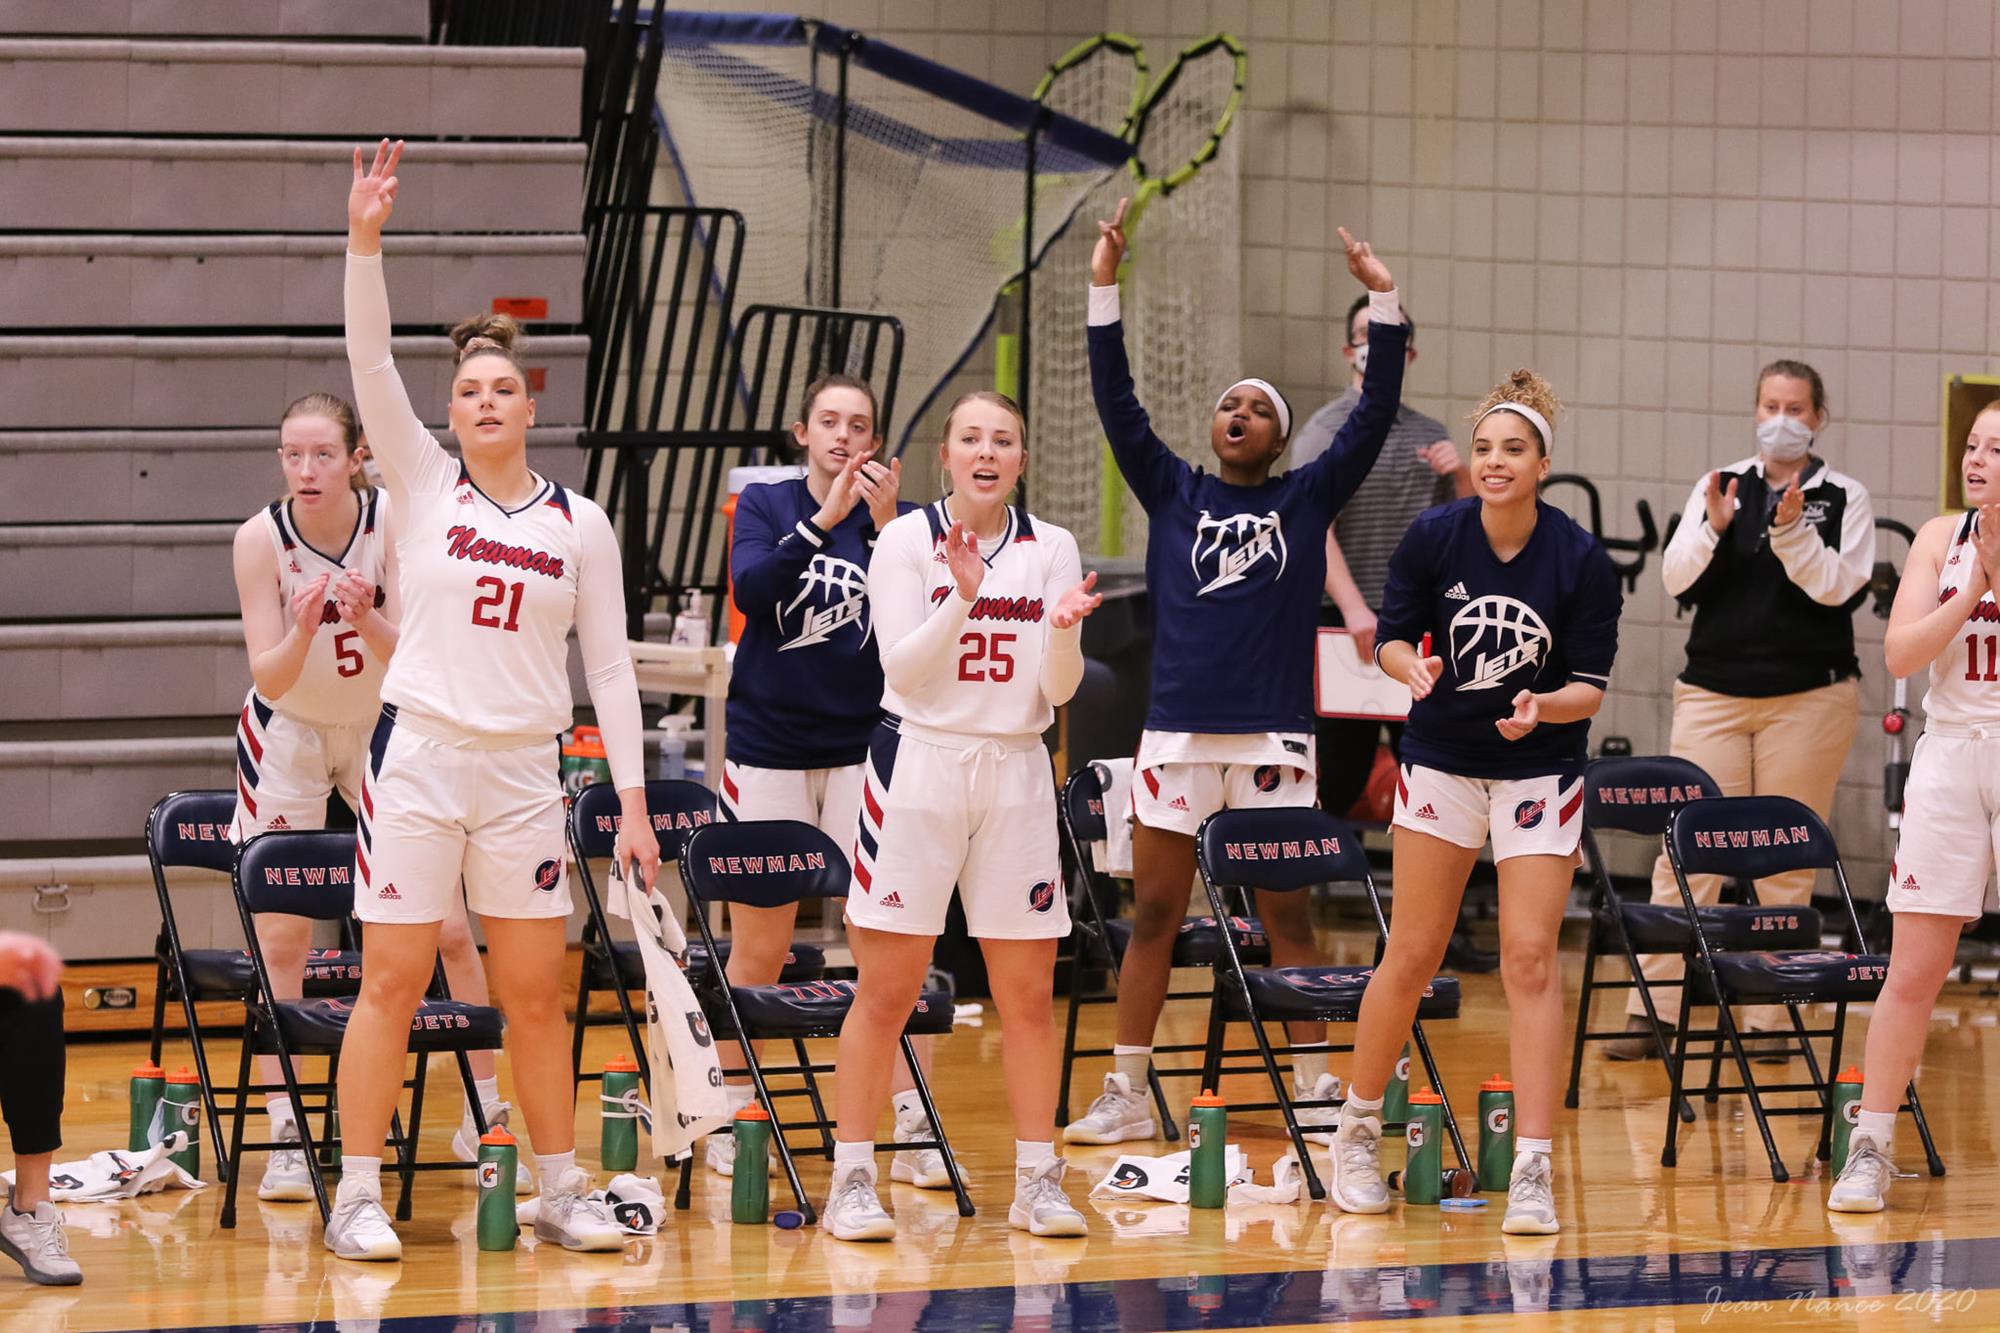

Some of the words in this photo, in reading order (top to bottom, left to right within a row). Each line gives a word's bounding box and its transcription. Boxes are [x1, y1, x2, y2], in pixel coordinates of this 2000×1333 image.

[447, 525, 564, 579] Newman
[472, 576, 525, 632] 21
[931, 586, 1044, 623] wman
[1445, 592, 1470, 601] adidas
[334, 630, 364, 678] 5
[958, 633, 1017, 682] 25
[1965, 634, 1997, 682] 11
[1598, 785, 1702, 804] NEWMAN
[595, 810, 712, 832] NMAN
[1415, 811, 1439, 821] adidas
[178, 823, 231, 841] NEW
[1695, 826, 1809, 849] NEWMAN
[1225, 838, 1341, 860] NEWMAN
[708, 852, 826, 874] NEWMAN
[264, 866, 350, 885] NEWM
[880, 900, 904, 908] adidas
[1751, 916, 1799, 931] JETS
[304, 965, 362, 980] JETS
[1847, 966, 1886, 981] JET
[412, 1015, 470, 1030] JETS
[1488, 1108, 1509, 1134] G
[1406, 1122, 1423, 1147] G
[478, 1162, 498, 1189] G
